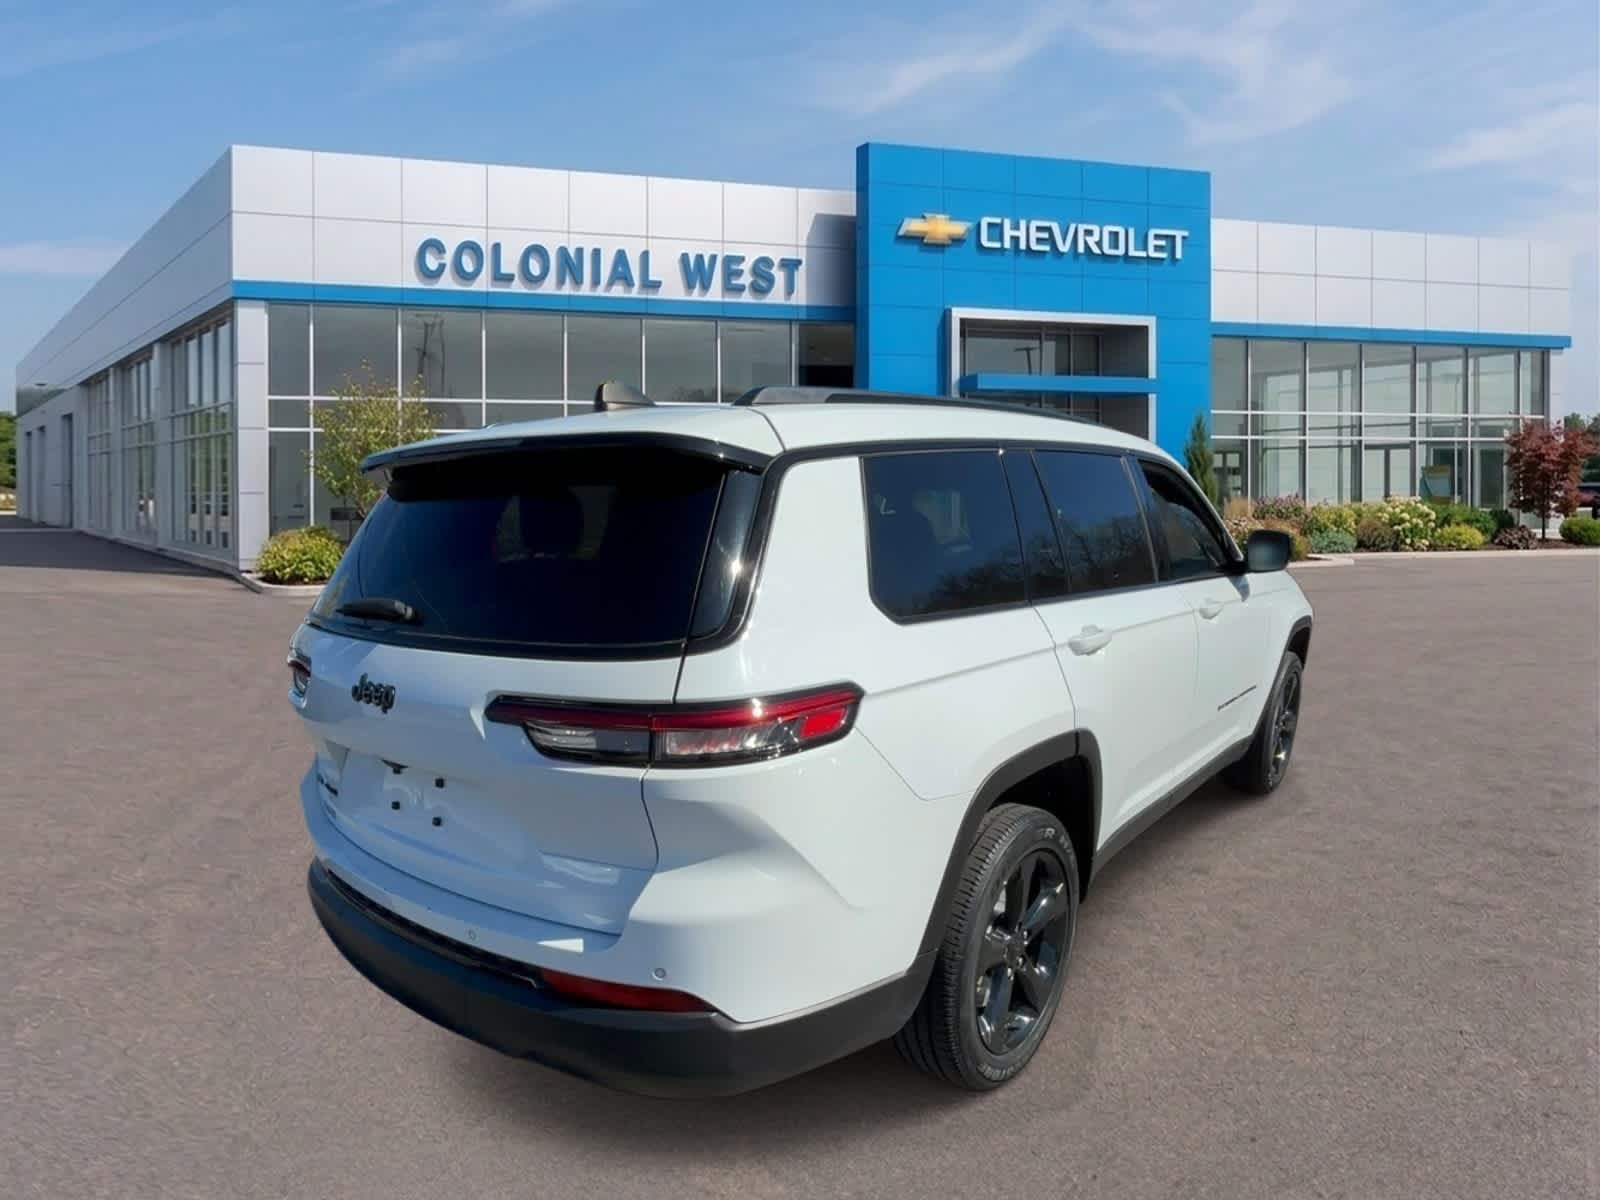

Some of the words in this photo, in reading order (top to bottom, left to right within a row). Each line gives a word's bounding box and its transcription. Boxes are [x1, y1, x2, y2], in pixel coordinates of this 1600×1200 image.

[979, 216, 1189, 260] CHEVROLET
[416, 238, 662, 289] COLONIAL
[680, 252, 803, 296] WEST
[351, 672, 395, 715] Jeep
